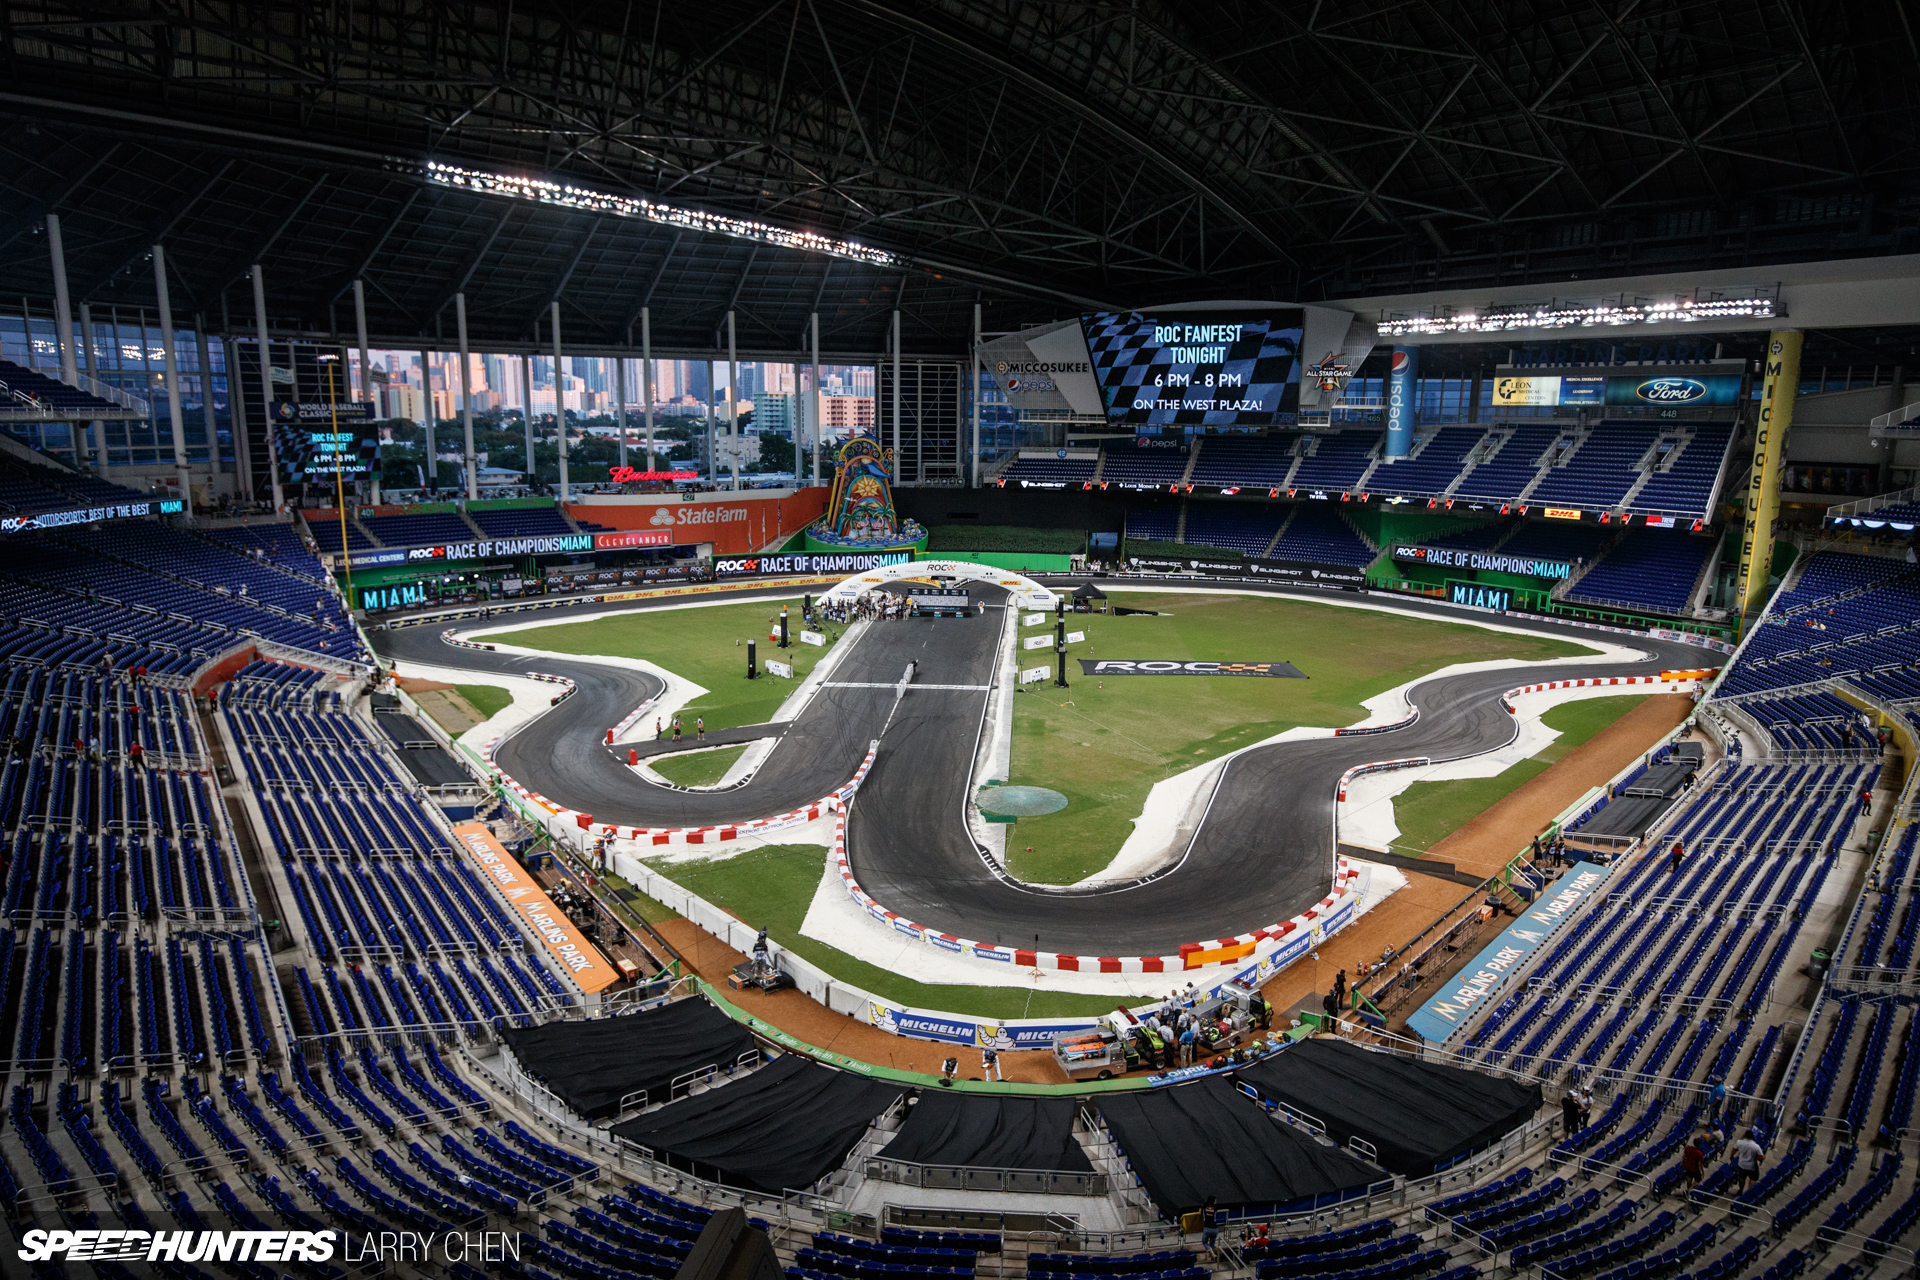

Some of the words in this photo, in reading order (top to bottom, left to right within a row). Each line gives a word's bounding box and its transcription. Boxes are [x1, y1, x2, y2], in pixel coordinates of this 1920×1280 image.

[1155, 325, 1181, 343] ROC
[1184, 325, 1243, 343] FANFEST
[1170, 347, 1226, 364] TONIGHT
[1513, 347, 1627, 368] MARLINS
[1638, 345, 1712, 366] PARK
[1010, 362, 1089, 373] MICCOSUKEE
[1020, 380, 1055, 392] pepsi
[1154, 374, 1164, 387] 6
[1167, 374, 1190, 387] PM
[1204, 374, 1214, 387] 8
[1218, 374, 1242, 387] PM
[1648, 382, 1693, 400] Ford
[298, 403, 328, 411] WORLD
[1133, 399, 1154, 410] ON
[1157, 399, 1180, 410] THE
[1182, 400, 1217, 411] WEST
[1219, 400, 1263, 411] PLAZA!
[1387, 379, 1405, 432] pepsi
[299, 410, 332, 418] CLASSIC
[1660, 410, 1677, 418] 448
[311, 432, 325, 442] ROC
[320, 442, 347, 452] TONIHT
[1151, 439, 1178, 449] pepsi
[313, 454, 320, 463] 6
[320, 454, 333, 462] PM
[344, 454, 356, 462] PM
[609, 466, 699, 483] Budweiser
[1, 517, 21, 530] ROC
[88, 507, 105, 521] BEST
[106, 506, 116, 519] OF
[116, 504, 132, 518] THE
[132, 503, 150, 516] BEST
[160, 500, 183, 514] MIAMI
[360, 508, 375, 517] 401
[1549, 510, 1575, 518] DHL
[598, 535, 669, 547] CLEVELANDER
[408, 548, 434, 559] ROC
[446, 543, 477, 560] RACE
[478, 541, 493, 558] OF
[352, 556, 379, 565] MEDICAL
[379, 553, 405, 563] CENTERS
[1138, 559, 1182, 567] SLINGSHOT
[1395, 547, 1417, 557] ROC
[1426, 549, 1453, 565] RACE
[1454, 552, 1469, 567] OF
[715, 559, 745, 572] ROC
[761, 557, 791, 573] RACE
[794, 556, 809, 571] OF
[927, 564, 948, 572] ROC
[1198, 563, 1243, 571] SLINGSHOT
[1258, 567, 1303, 576] SLINGSHOT
[1319, 572, 1365, 582] SLINGSHOT
[574, 574, 589, 582] ROC
[363, 585, 424, 610] MIAMI
[1453, 585, 1508, 611] MIAMI
[1094, 661, 1222, 671] ROC
[460, 832, 501, 865] MARLINS
[487, 862, 519, 886] PARK
[517, 900, 570, 945] MARLINS
[554, 942, 596, 974] PARK
[1326, 907, 1354, 930] MICHELIN
[895, 923, 920, 937] MICHELIN
[933, 938, 961, 950] MICHELIN
[1275, 935, 1311, 964] MICHELIN
[1430, 969, 1500, 1023] MARLINS
[1485, 944, 1526, 973] PARK
[1528, 888, 1583, 926] MARLINS
[1569, 870, 1602, 895] PARK
[976, 950, 1010, 960] MICHELIN
[898, 1017, 974, 1038] MICHELIN
